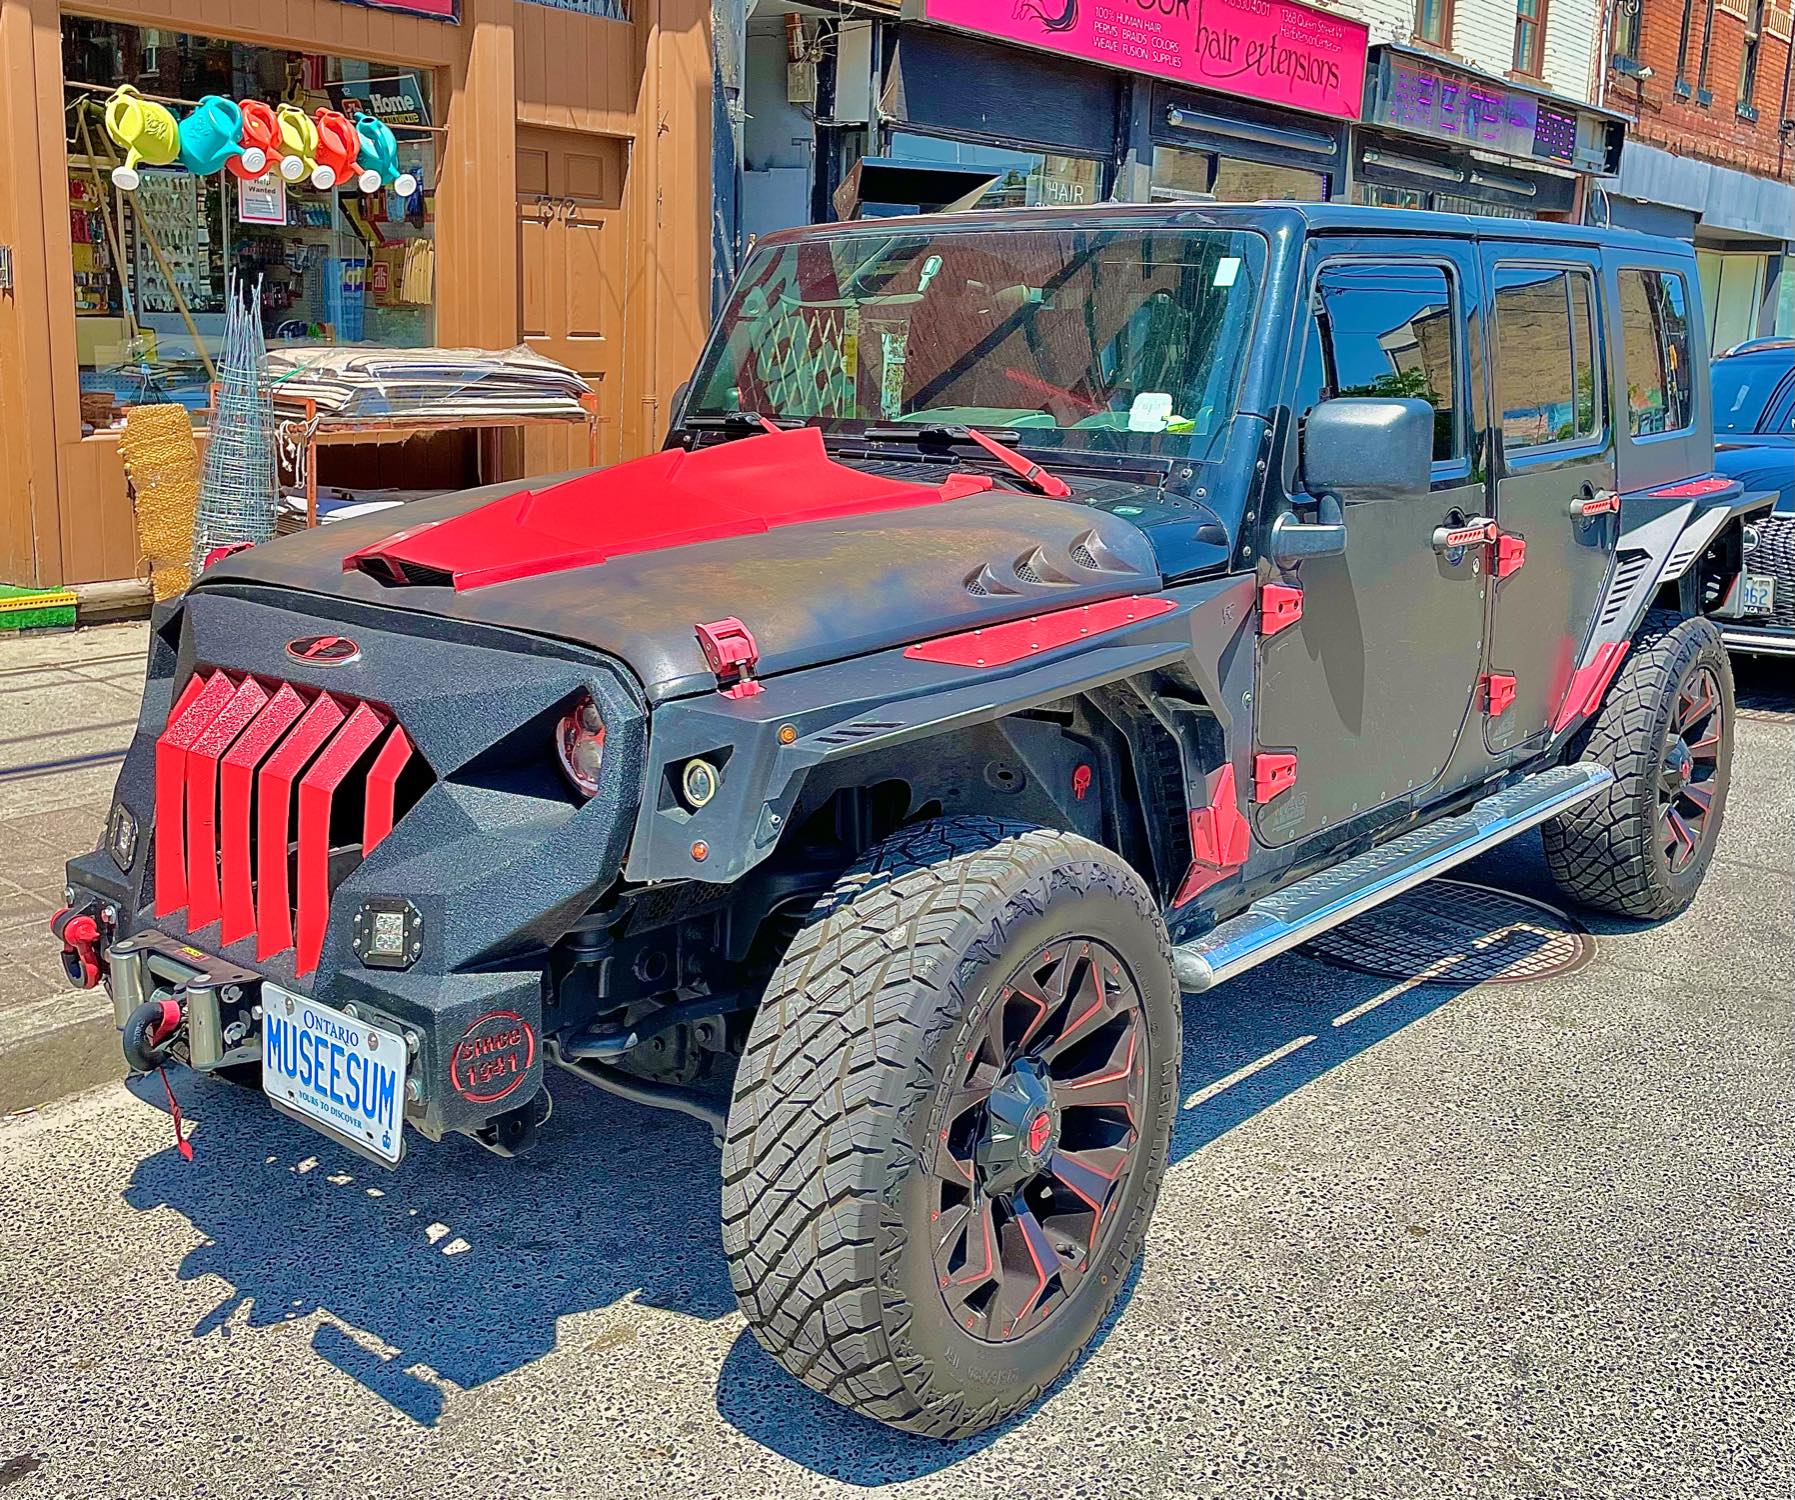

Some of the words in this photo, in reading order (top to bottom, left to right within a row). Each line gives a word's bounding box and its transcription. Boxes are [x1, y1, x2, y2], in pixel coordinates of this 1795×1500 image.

[1094, 21, 1118, 37] PERMS
[1122, 29, 1148, 45] BRAIDS
[1151, 37, 1180, 53] COLORS
[1116, 13, 1143, 29] HUMAN
[1144, 21, 1162, 33] HAIR
[1093, 36, 1119, 52] WEAVE
[1122, 44, 1149, 60] FUSION
[1152, 51, 1182, 68] SUPPLIES
[1195, 0, 1241, 70] hair
[1245, 34, 1340, 99] extensions
[369, 93, 416, 113] Home
[248, 186, 276, 194] Wanted
[1047, 181, 1084, 204] HAIR
[303, 1010, 359, 1047] ONTARIO
[267, 1014, 396, 1130] MUSEESUM
[299, 1090, 319, 1107] YOURS
[320, 1101, 330, 1112] TO
[330, 1107, 363, 1129] DISCOVER
